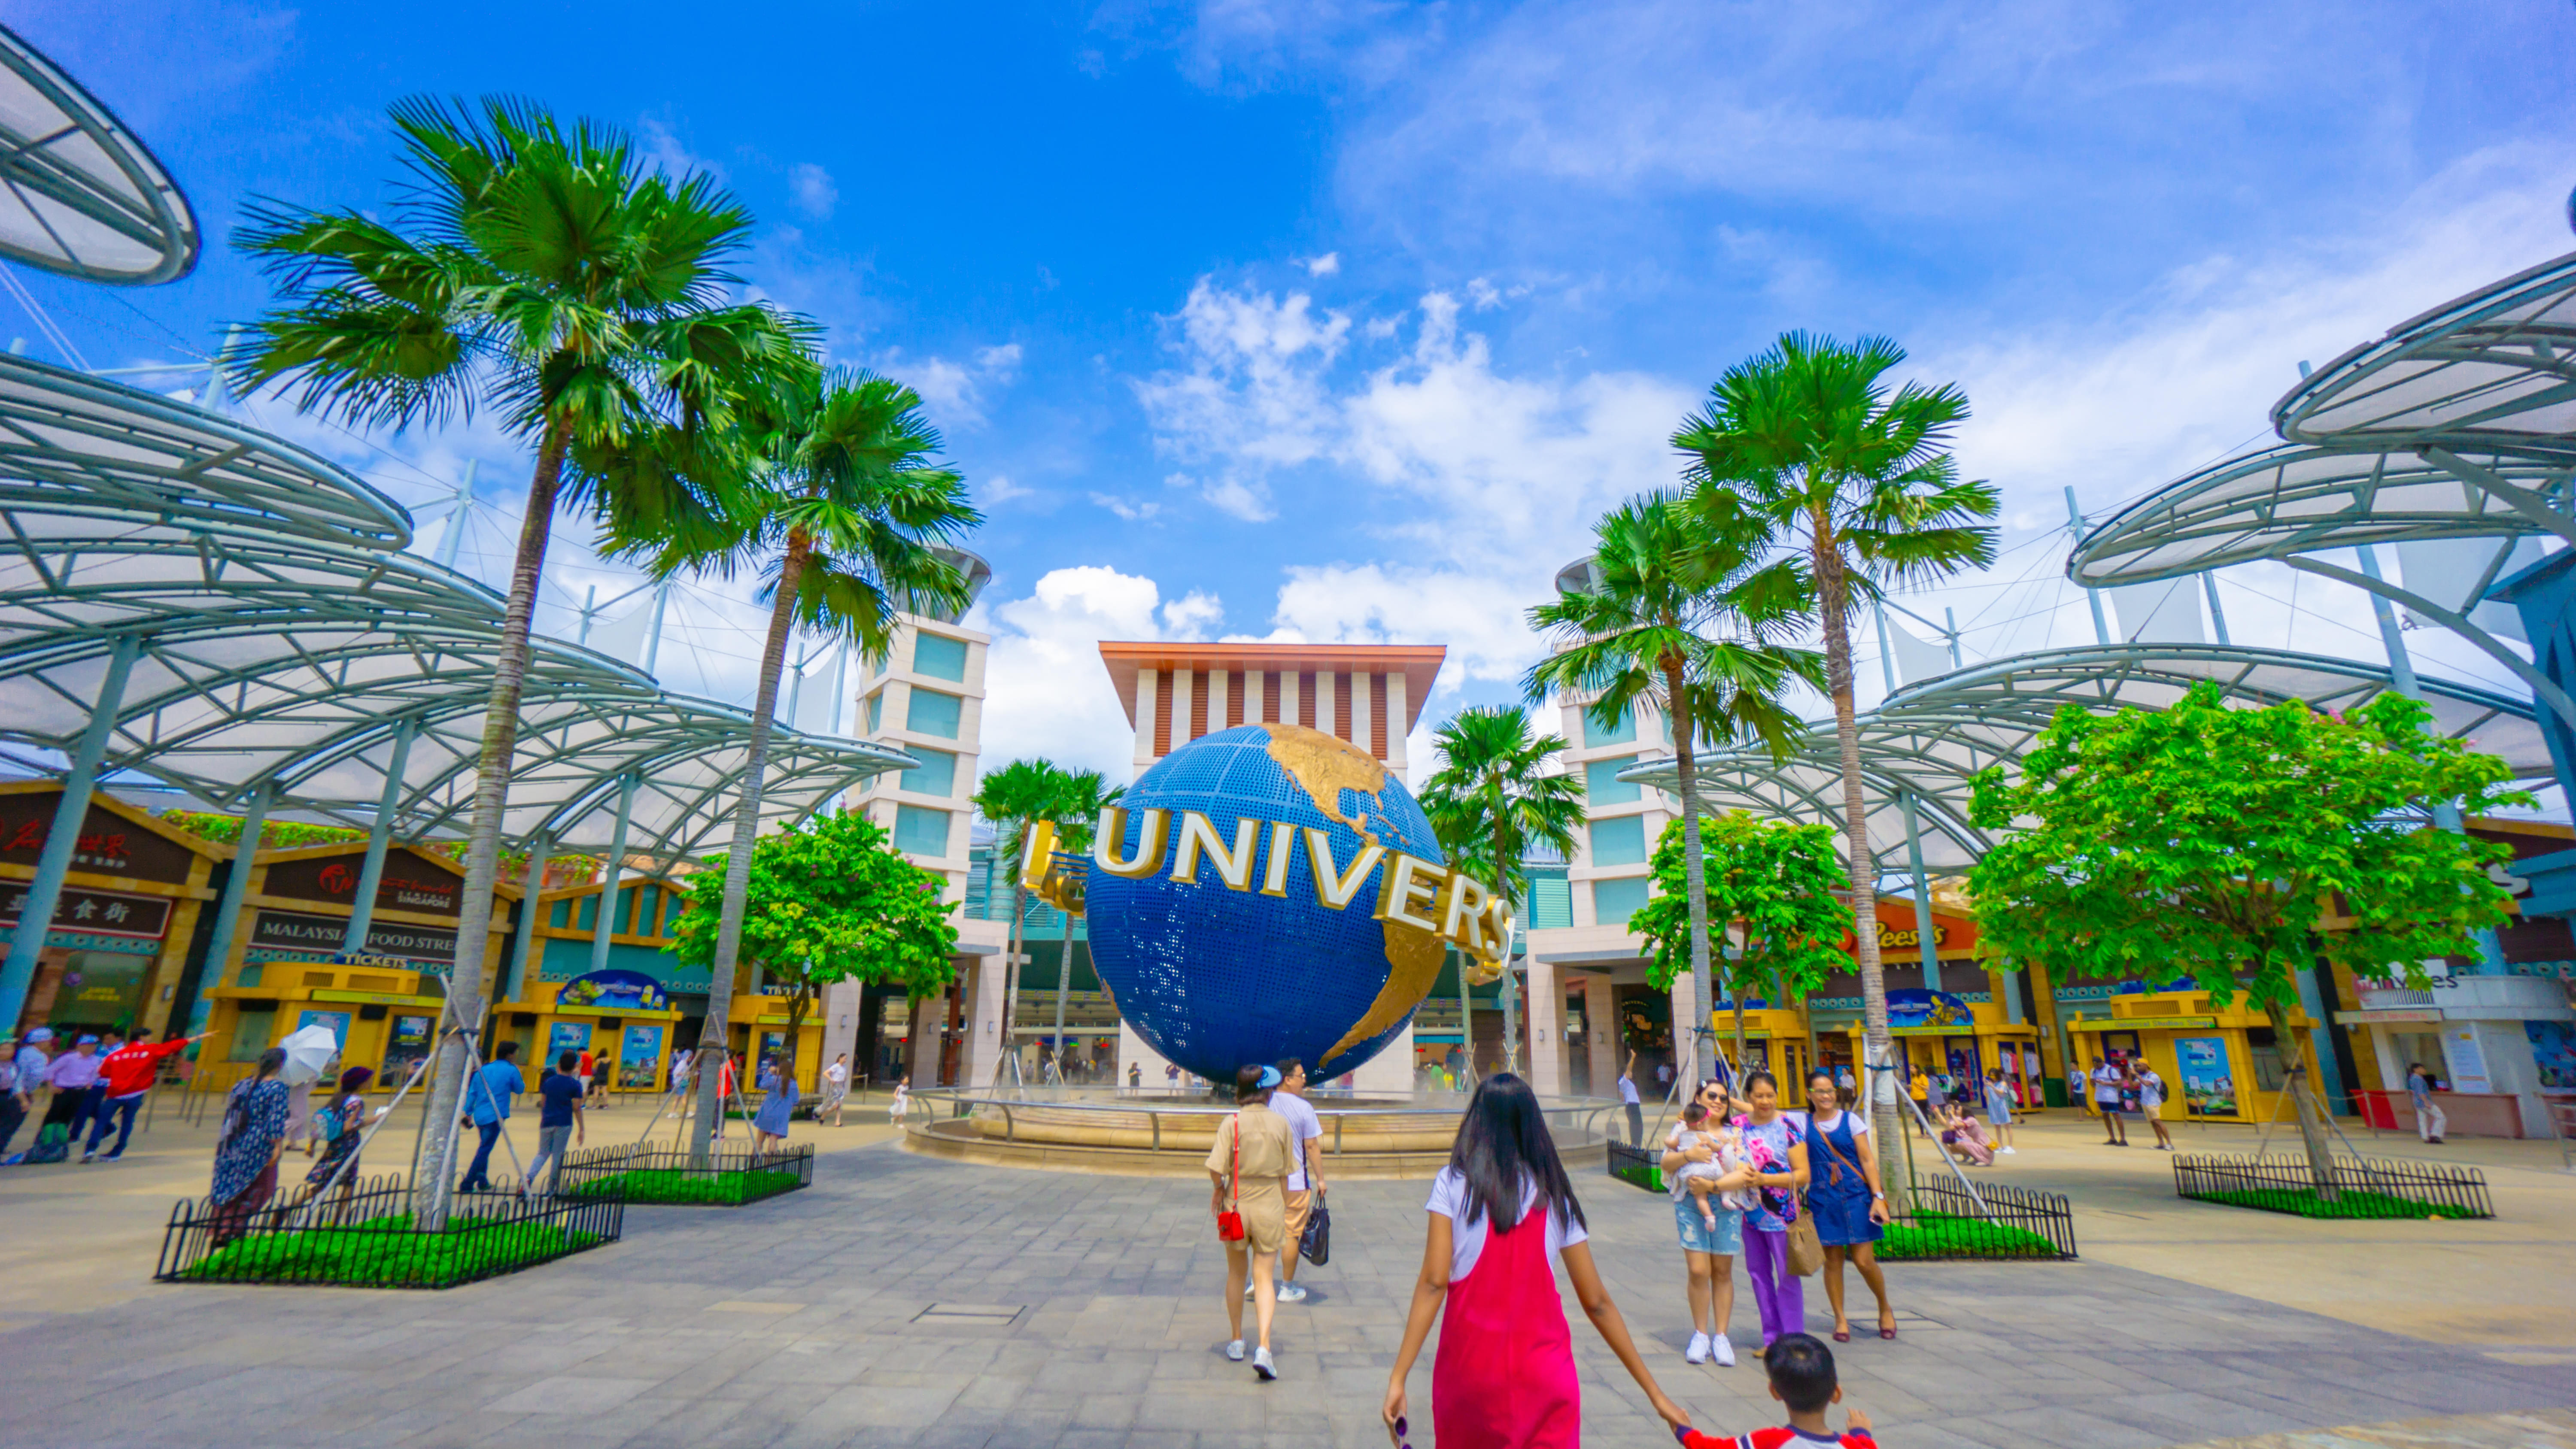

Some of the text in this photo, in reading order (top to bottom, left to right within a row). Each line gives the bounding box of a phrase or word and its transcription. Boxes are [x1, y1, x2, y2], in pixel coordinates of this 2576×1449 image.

[263, 922, 454, 951] MALAYSI FOOD STRE
[1876, 922, 1945, 947] ees's
[344, 953, 407, 969] TICKETS
